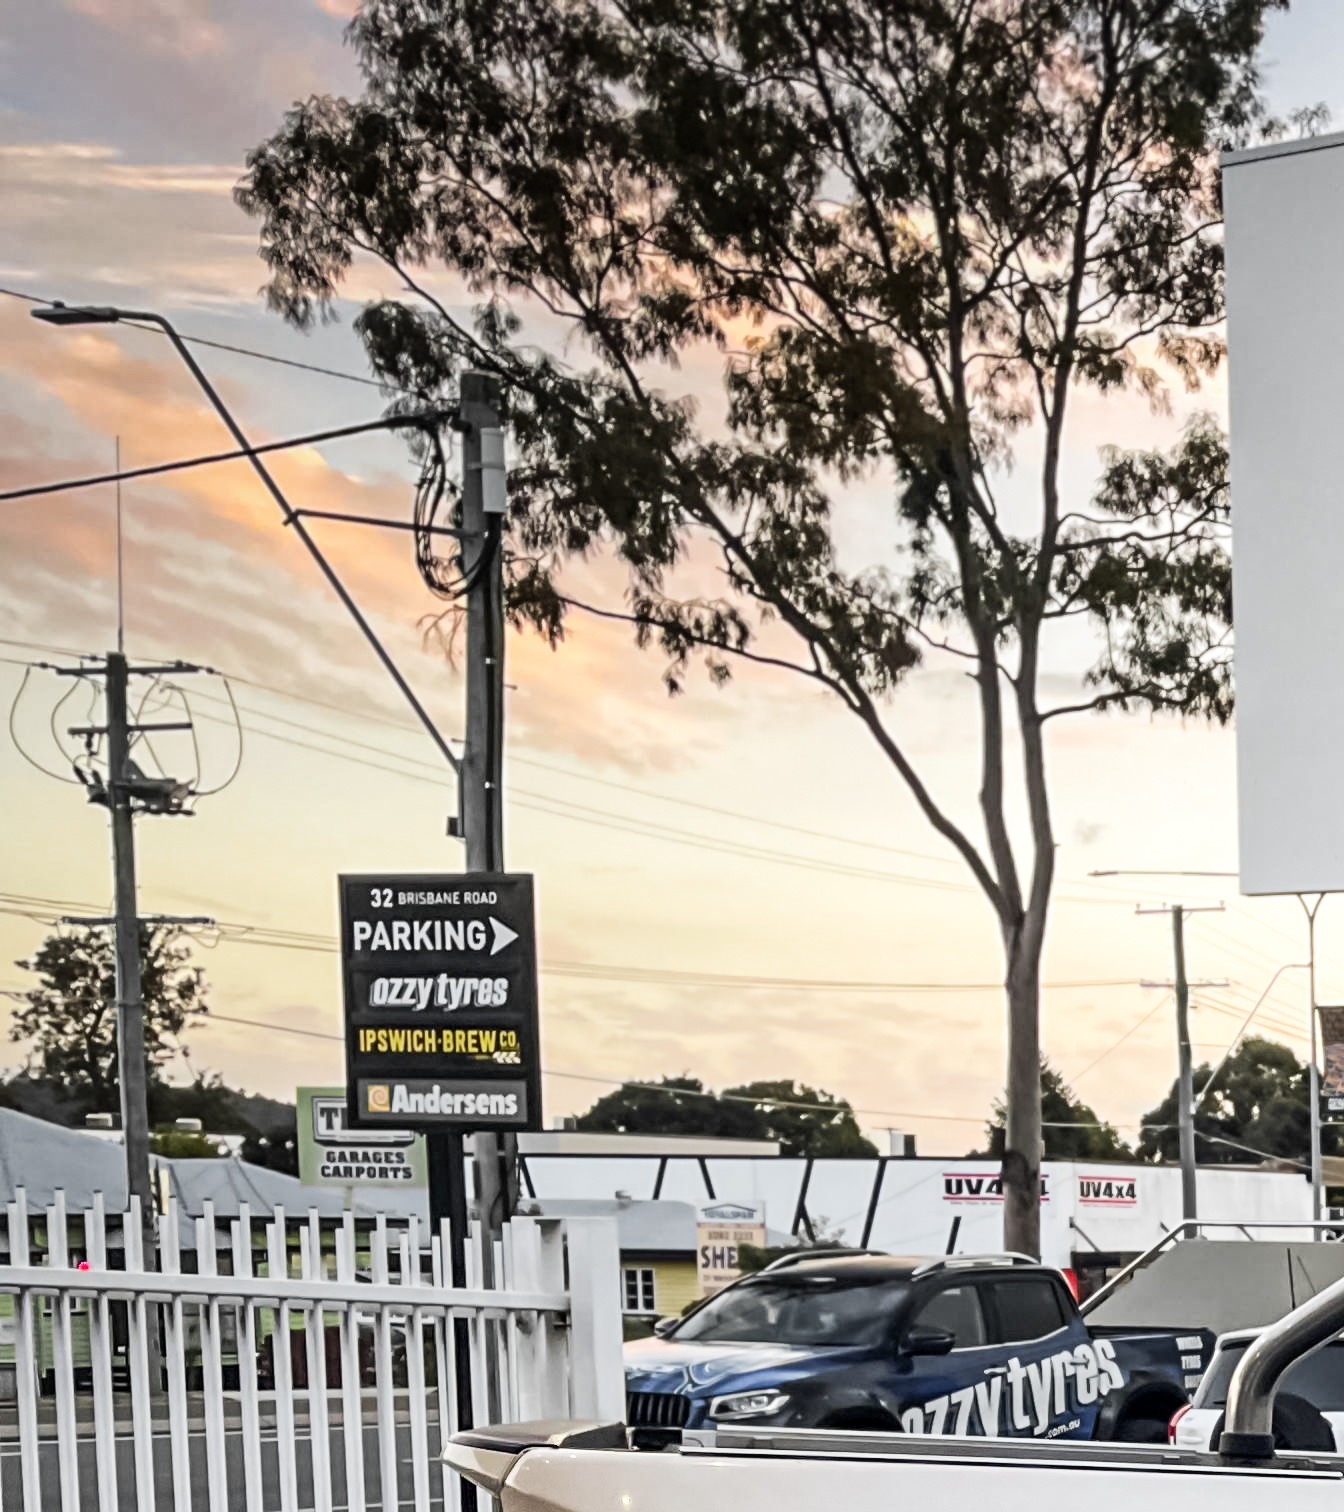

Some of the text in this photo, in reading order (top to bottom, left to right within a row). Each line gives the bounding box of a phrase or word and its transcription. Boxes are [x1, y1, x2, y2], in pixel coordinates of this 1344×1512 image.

[370, 888, 498, 908] 32 BRISBANE ROAD
[353, 920, 487, 951] PARKING
[369, 973, 509, 1011] ozzy tyres
[391, 1085, 518, 1115] Andersens
[326, 1151, 405, 1164] GARAGES
[320, 1165, 413, 1179] CARPORTS
[1079, 1181, 1137, 1199] UV4x4
[1006, 1339, 1125, 1436] tyres
